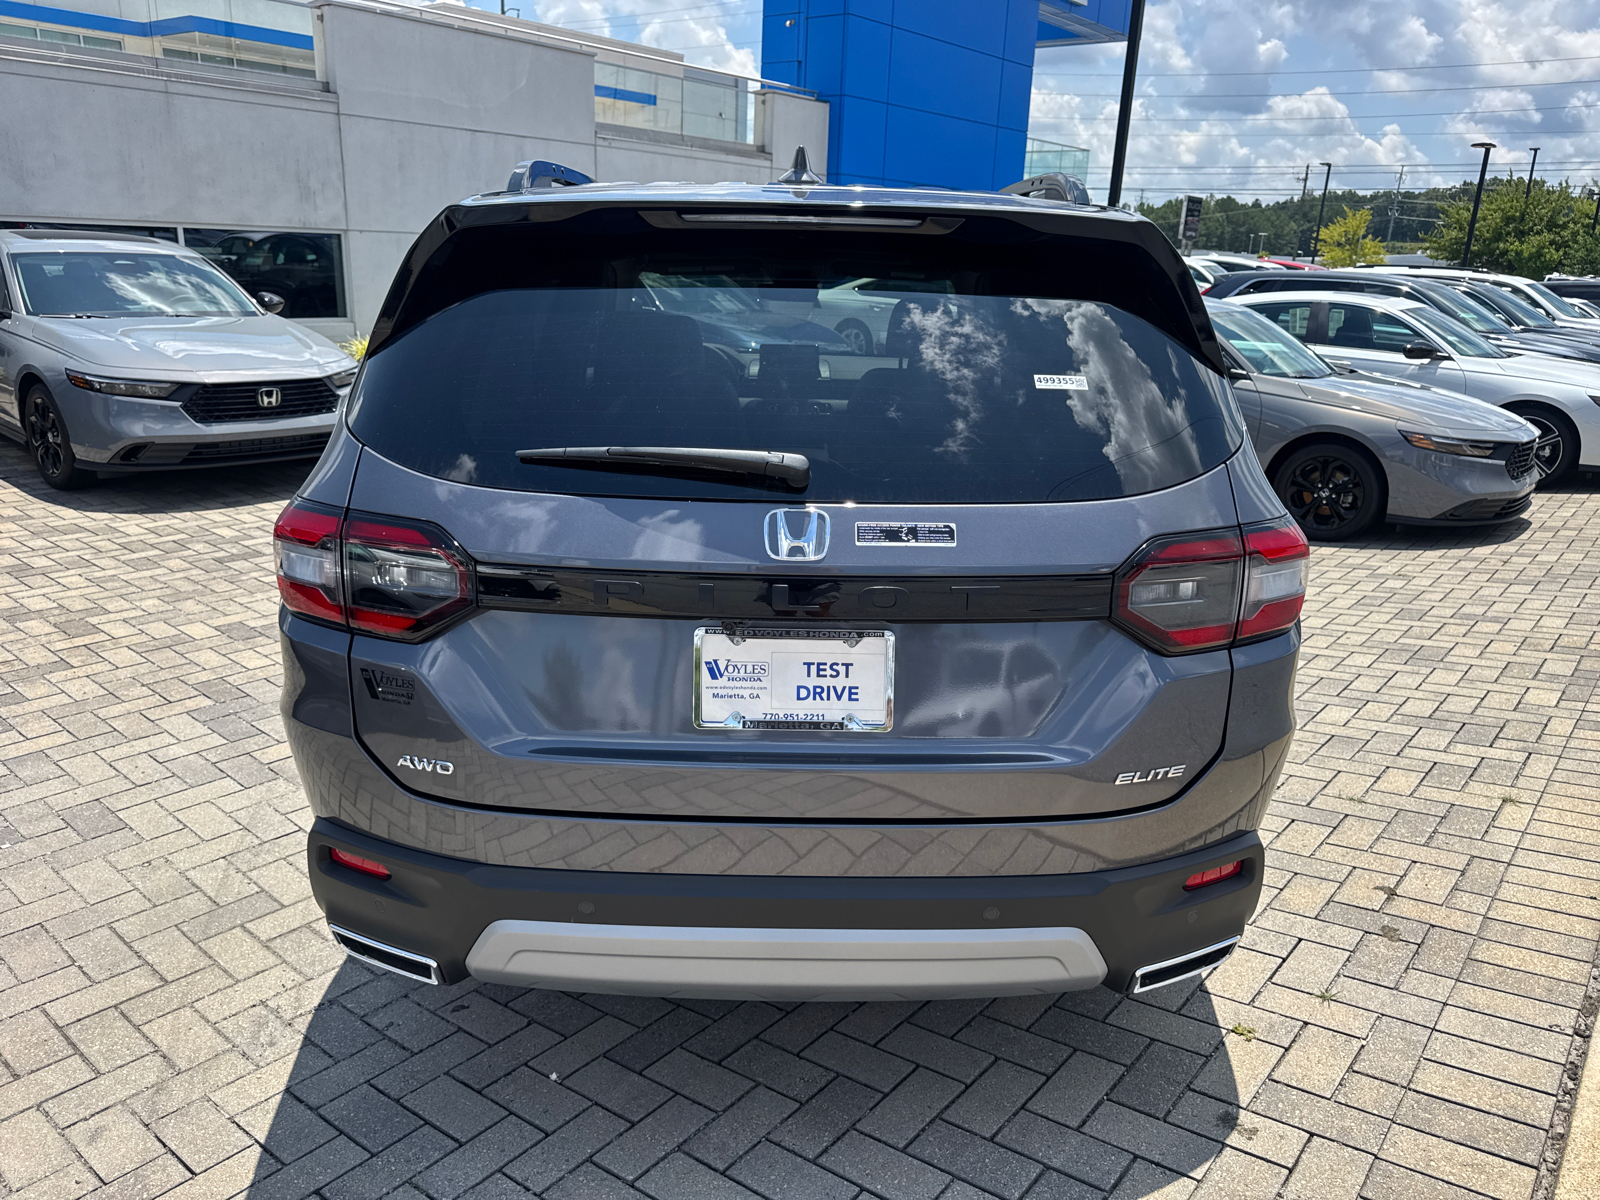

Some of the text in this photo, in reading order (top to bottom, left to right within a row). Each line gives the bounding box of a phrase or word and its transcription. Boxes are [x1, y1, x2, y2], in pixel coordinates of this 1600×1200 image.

[1036, 376, 1075, 385] 499355
[593, 579, 1000, 611] PILOT
[712, 658, 767, 679] VOYLES
[803, 661, 854, 679] TEST
[370, 669, 414, 690] VOYLES
[712, 692, 761, 700] Marietta, GA
[796, 684, 860, 702] DRIVE
[744, 720, 842, 730] Marietta, GA
[762, 712, 825, 721] 770-951-2211
[397, 754, 455, 775] AWD
[1114, 764, 1187, 786] ELITE
